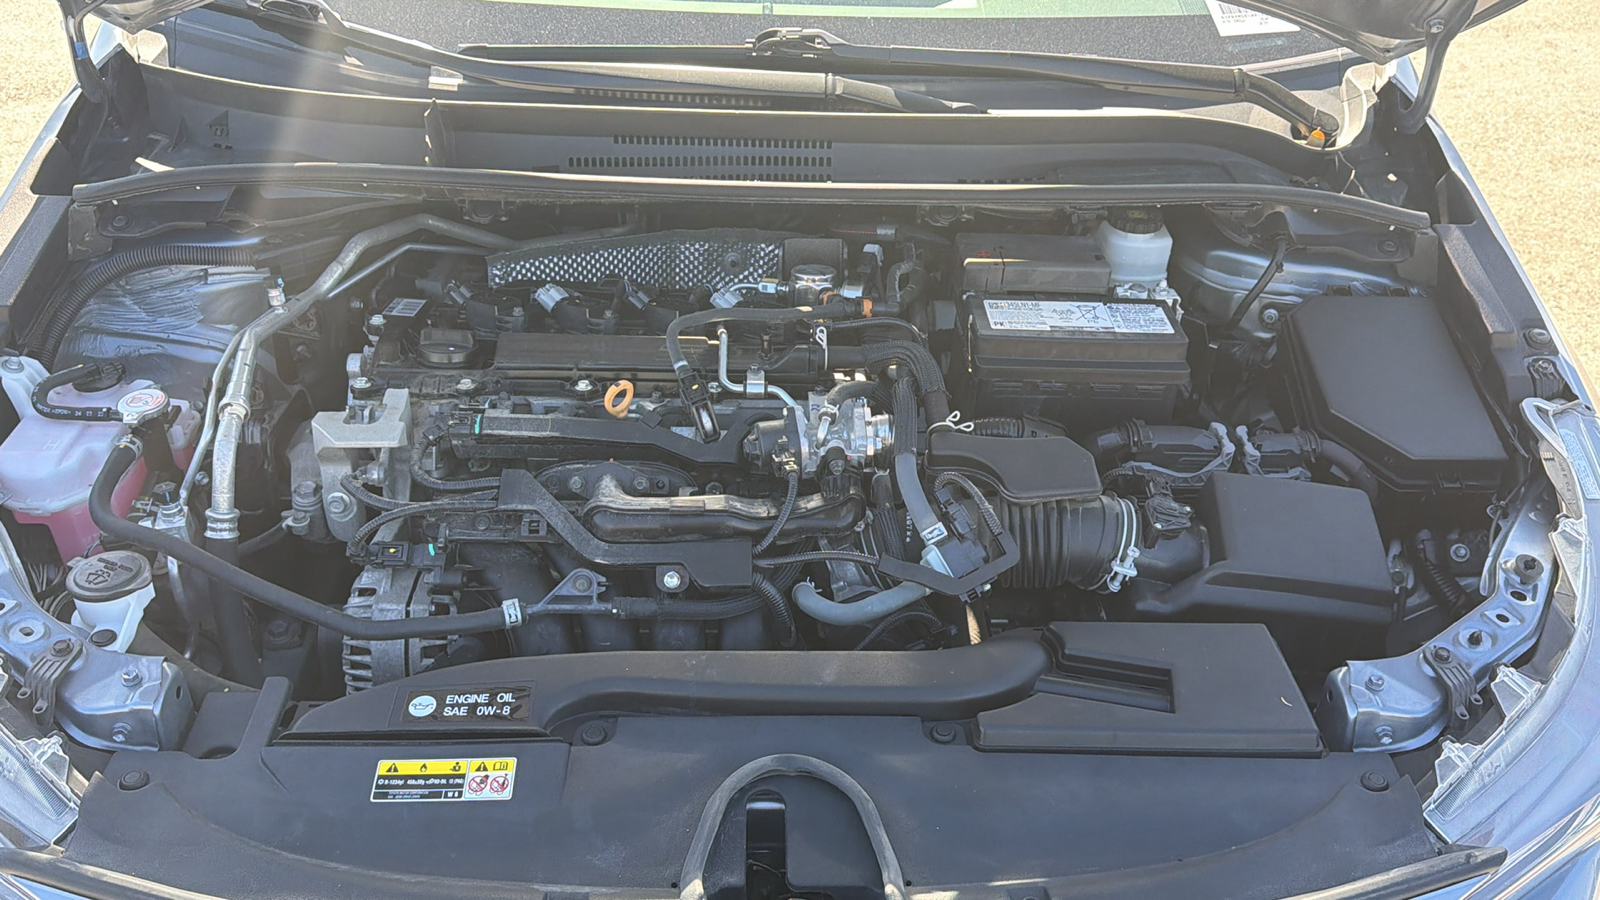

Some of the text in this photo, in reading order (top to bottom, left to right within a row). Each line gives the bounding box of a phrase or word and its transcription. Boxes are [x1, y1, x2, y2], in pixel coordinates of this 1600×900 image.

[445, 692, 516, 704] ENGINE OIL
[443, 705, 511, 716] SAE 0W-8
